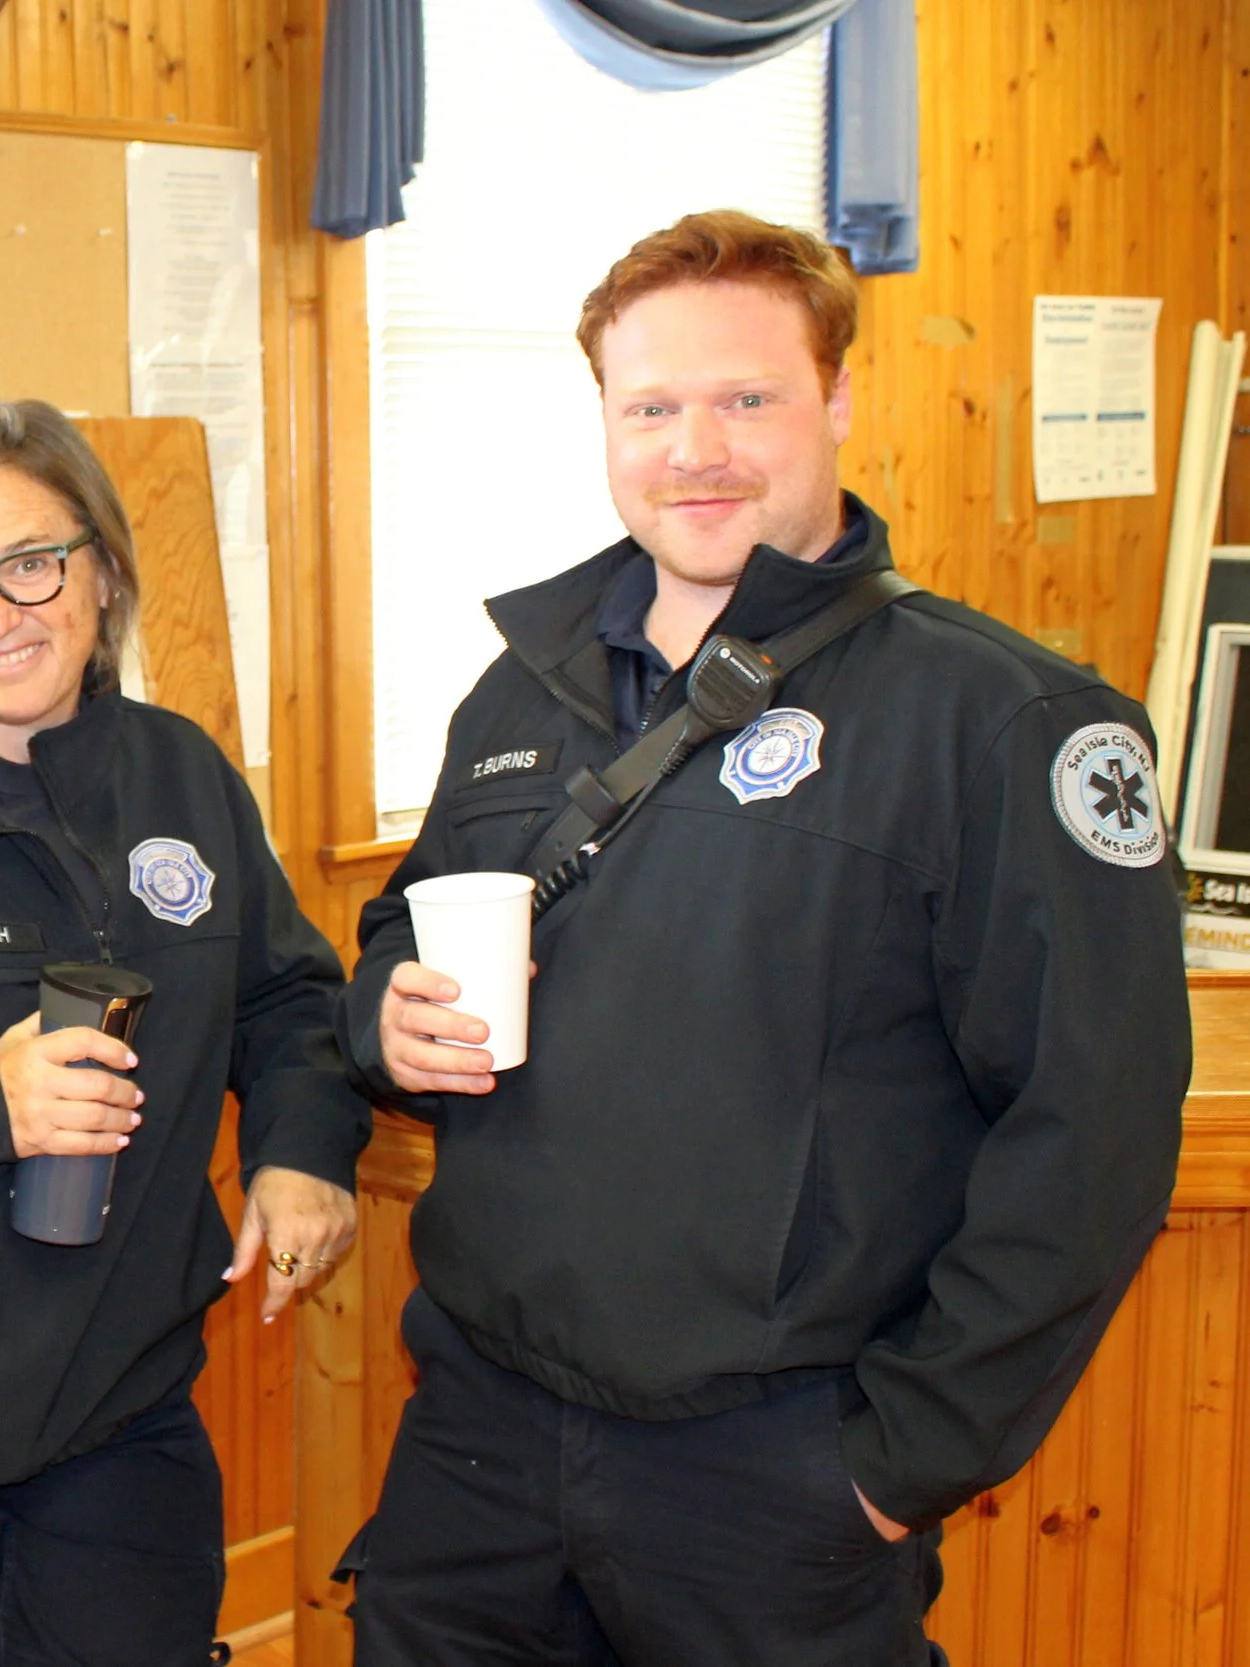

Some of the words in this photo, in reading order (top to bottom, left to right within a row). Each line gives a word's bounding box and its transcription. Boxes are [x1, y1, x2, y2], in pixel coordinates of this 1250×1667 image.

[1067, 747, 1088, 771] Sea
[1085, 736, 1109, 751] Isle
[1090, 829, 1121, 853] EMS
[1123, 831, 1160, 856] Division
[1203, 878, 1236, 902] Sea
